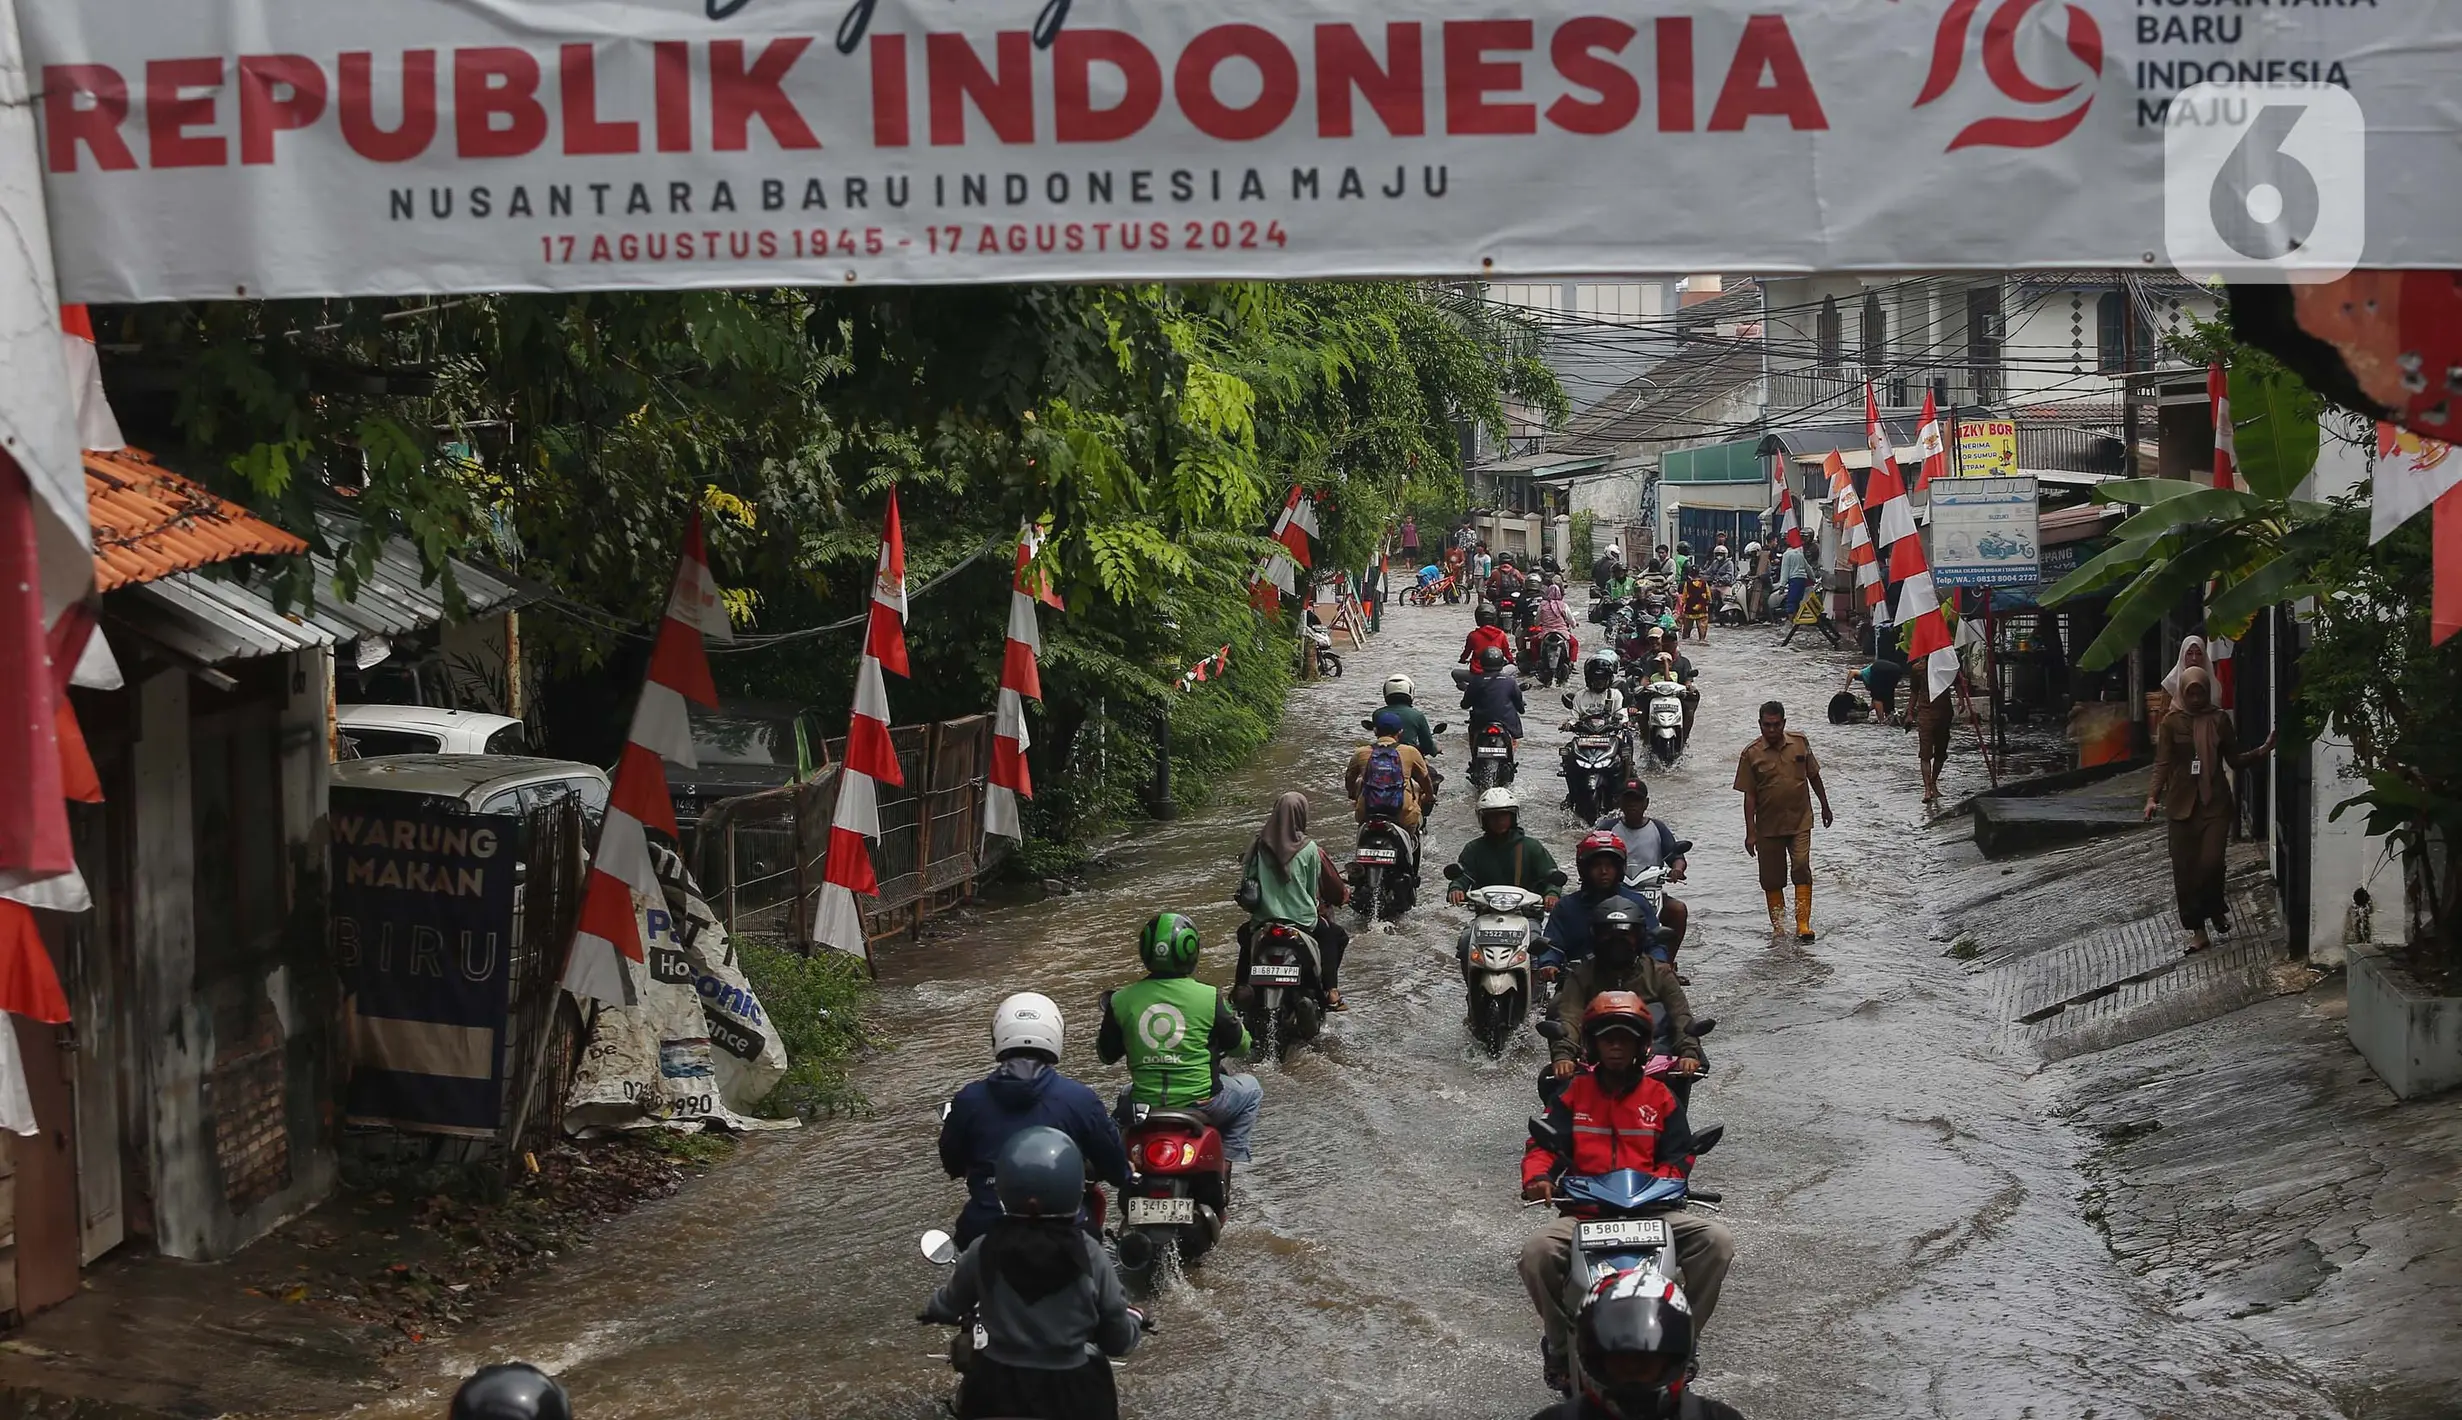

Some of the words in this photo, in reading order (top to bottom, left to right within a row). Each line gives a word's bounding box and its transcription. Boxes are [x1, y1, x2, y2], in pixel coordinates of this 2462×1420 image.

[2137, 15, 2242, 44] BARU
[2137, 61, 2351, 90] INDONESIA
[42, 36, 822, 172] REPUBLIK
[870, 15, 1830, 148] INDONESIA
[2138, 98, 2248, 127] MAJU
[391, 180, 737, 219] NUSANTARA
[763, 174, 910, 212] BARU
[935, 169, 1267, 206] INDONESIA
[1292, 165, 1448, 200] MAJU
[541, 236, 575, 264] 17
[591, 231, 778, 262] AGUSTUS
[793, 227, 883, 257] 1945
[926, 226, 962, 255] 17
[977, 222, 1168, 254] AGUSTUS
[1185, 220, 1287, 250] 2024
[1957, 424, 1985, 438] IZKY
[1989, 423, 2013, 436] BOR
[1960, 442, 1990, 451] NERIMA
[331, 814, 498, 858] WARUNG
[347, 855, 484, 897] MAKAN
[334, 916, 498, 981] BIRU
[691, 965, 762, 1027] onic
[1130, 1200, 1136, 1212] B
[1143, 1200, 1168, 1211] 5416
[1172, 1200, 1191, 1211] TPY
[1583, 1225, 1590, 1235] B
[1596, 1223, 1626, 1234] 5801
[1636, 1221, 1660, 1232] TDE
